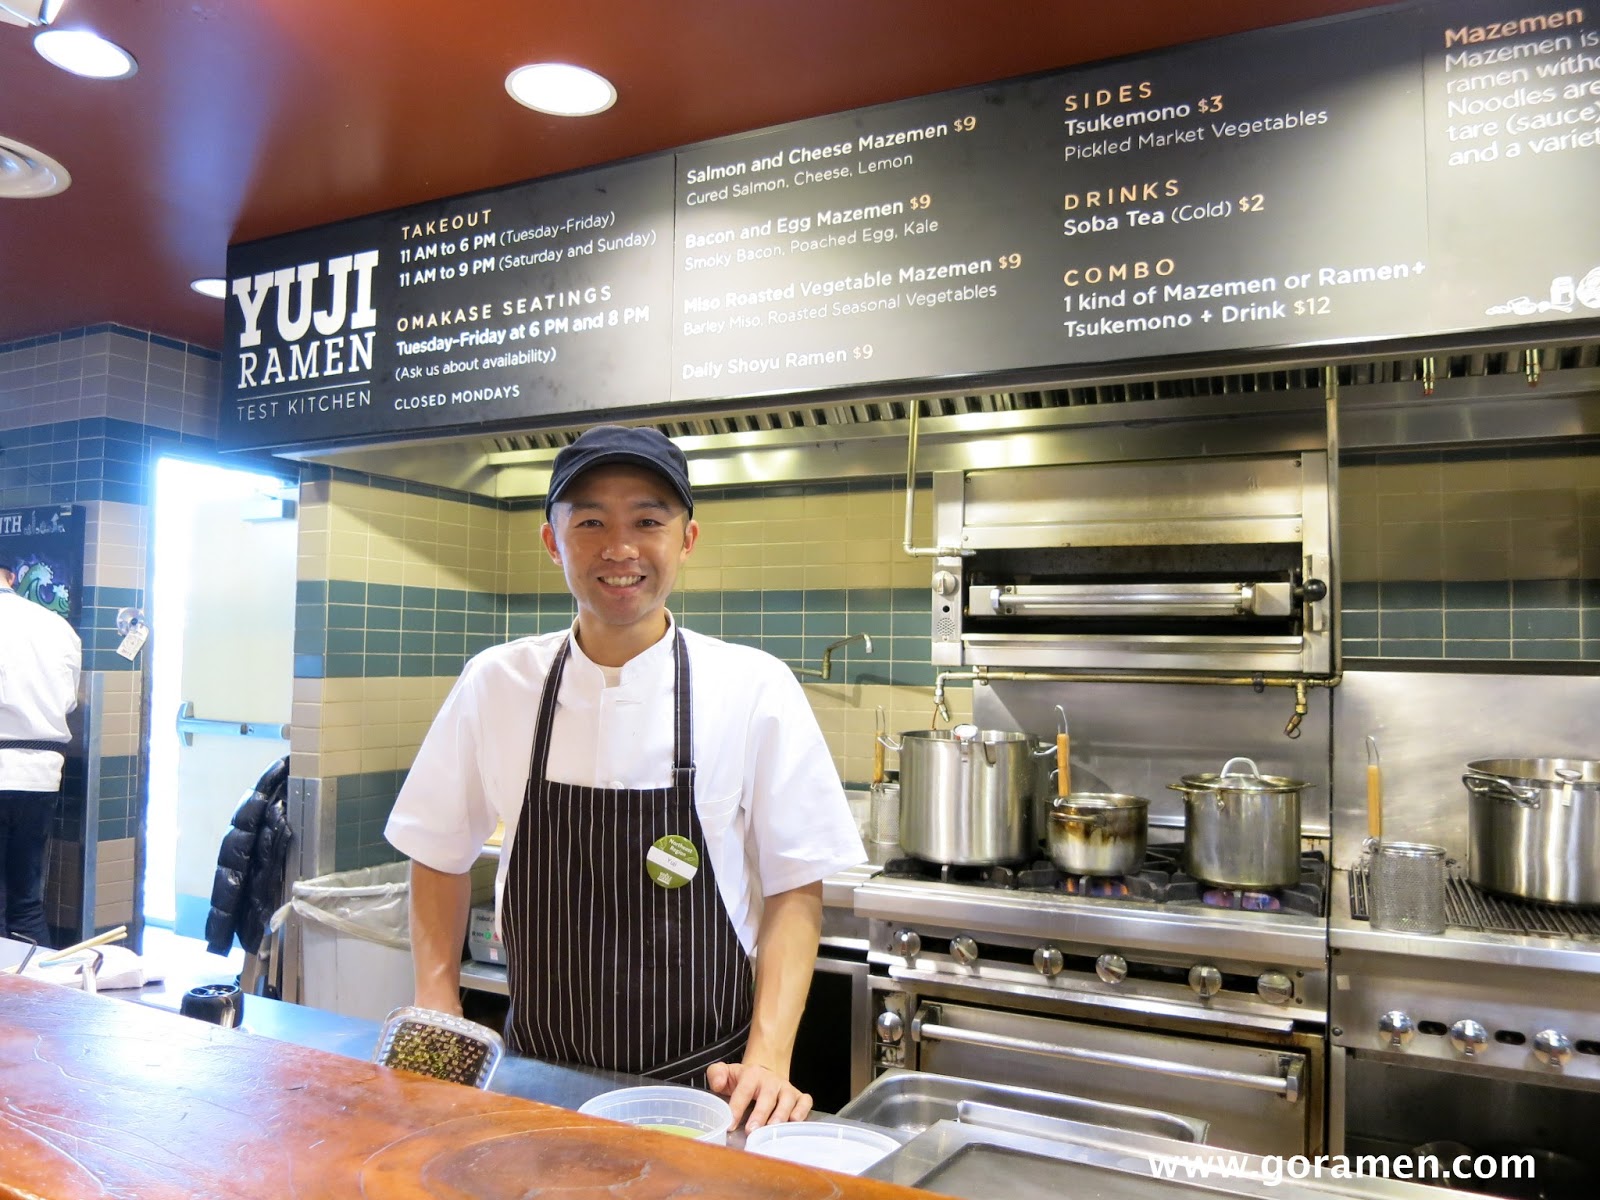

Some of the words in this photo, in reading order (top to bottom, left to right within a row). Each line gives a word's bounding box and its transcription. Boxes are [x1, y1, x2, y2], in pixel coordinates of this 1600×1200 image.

[1444, 7, 1584, 49] Mazemen
[1445, 35, 1572, 72] Mazemen
[1580, 29, 1600, 48] is
[1064, 81, 1153, 112] SIDES
[1446, 68, 1530, 94] ramen
[1447, 86, 1556, 118] Noodles
[1563, 80, 1600, 99] are
[1064, 103, 1191, 137] Tsukemono
[1198, 95, 1224, 114] $3
[1064, 137, 1132, 162] Pickled
[1138, 126, 1204, 150] Market
[1211, 108, 1328, 138] Vegetables
[1446, 121, 1499, 141] tare
[687, 162, 746, 185] Salmon
[752, 152, 783, 173] and
[789, 141, 852, 165] Cheese
[858, 123, 948, 151] Mazemen
[953, 116, 976, 133] $9
[1448, 141, 1498, 166] and
[1506, 142, 1521, 158] a
[687, 187, 728, 206] Cured
[732, 176, 789, 198] Salmon,
[794, 165, 852, 187] Cheese,
[858, 154, 913, 175] Lemon
[1064, 179, 1180, 211] DRINKS
[402, 209, 491, 240] TAKEOUT
[685, 229, 734, 249] Bacon
[740, 221, 771, 240] and
[777, 216, 811, 235] Egg
[817, 200, 903, 227] Mazemen
[909, 194, 931, 211] $9
[1064, 215, 1119, 237] Soba
[1126, 209, 1165, 227] Tea
[1171, 200, 1232, 224] (Cold)
[1239, 194, 1264, 213] $2
[400, 249, 410, 264] 11
[414, 245, 437, 261] AM
[441, 243, 455, 257] to
[460, 239, 469, 253] 6
[474, 232, 496, 250] PM
[500, 211, 615, 247] (Tuesday-Friday)
[400, 273, 410, 287] 11
[414, 268, 436, 285] AM
[440, 265, 454, 280] to
[459, 262, 468, 277] 9
[473, 257, 495, 274] PM
[499, 247, 562, 272] (Saturday
[567, 241, 593, 262] and
[597, 230, 657, 258] Sunday)
[684, 253, 731, 271] Smoky
[736, 243, 785, 262] Bacon,
[790, 230, 856, 254] Poached
[862, 227, 898, 243] Egg,
[904, 219, 939, 236] Kale
[684, 297, 720, 314] Miso
[726, 286, 794, 308] Roasted
[800, 271, 892, 299] Vegetable
[898, 259, 992, 284] Mazemen
[999, 253, 1022, 270] $9
[1064, 258, 1175, 287] COMBO
[1064, 296, 1071, 313] 1
[1078, 289, 1126, 311] kind
[1133, 285, 1157, 305] of
[1163, 275, 1276, 303] Mazemen
[1284, 272, 1312, 289] or
[232, 250, 379, 348] YUJI
[398, 304, 492, 332] OMAKASE
[503, 285, 612, 316] SEATINGS
[683, 319, 725, 336] Barley
[768, 304, 827, 325] Roasted
[832, 294, 900, 317] Seasonal
[906, 284, 997, 308] Vegetables
[1064, 311, 1192, 338] Tsukemono
[1201, 311, 1212, 323] +
[1222, 300, 1286, 323] Drink
[1294, 296, 1331, 316] $12
[396, 328, 506, 356] Tuesday-Friday
[510, 324, 525, 340] at
[530, 321, 539, 338] 6
[544, 318, 569, 334] PM
[573, 311, 603, 331] and
[608, 310, 618, 326] 8
[624, 305, 649, 324] PM
[237, 331, 376, 389] RAMEN
[395, 362, 422, 381] (Ask
[426, 364, 439, 375] us
[443, 357, 479, 374] about
[483, 347, 557, 370] availability)
[682, 362, 723, 380] Daily
[727, 354, 780, 375] Shoyu
[786, 348, 847, 367] Ramen
[853, 344, 873, 360] $9
[237, 402, 277, 421] TEST
[288, 390, 370, 416] KITCHEN
[394, 394, 446, 411] CLOSED
[452, 384, 520, 406] MONDAYS
